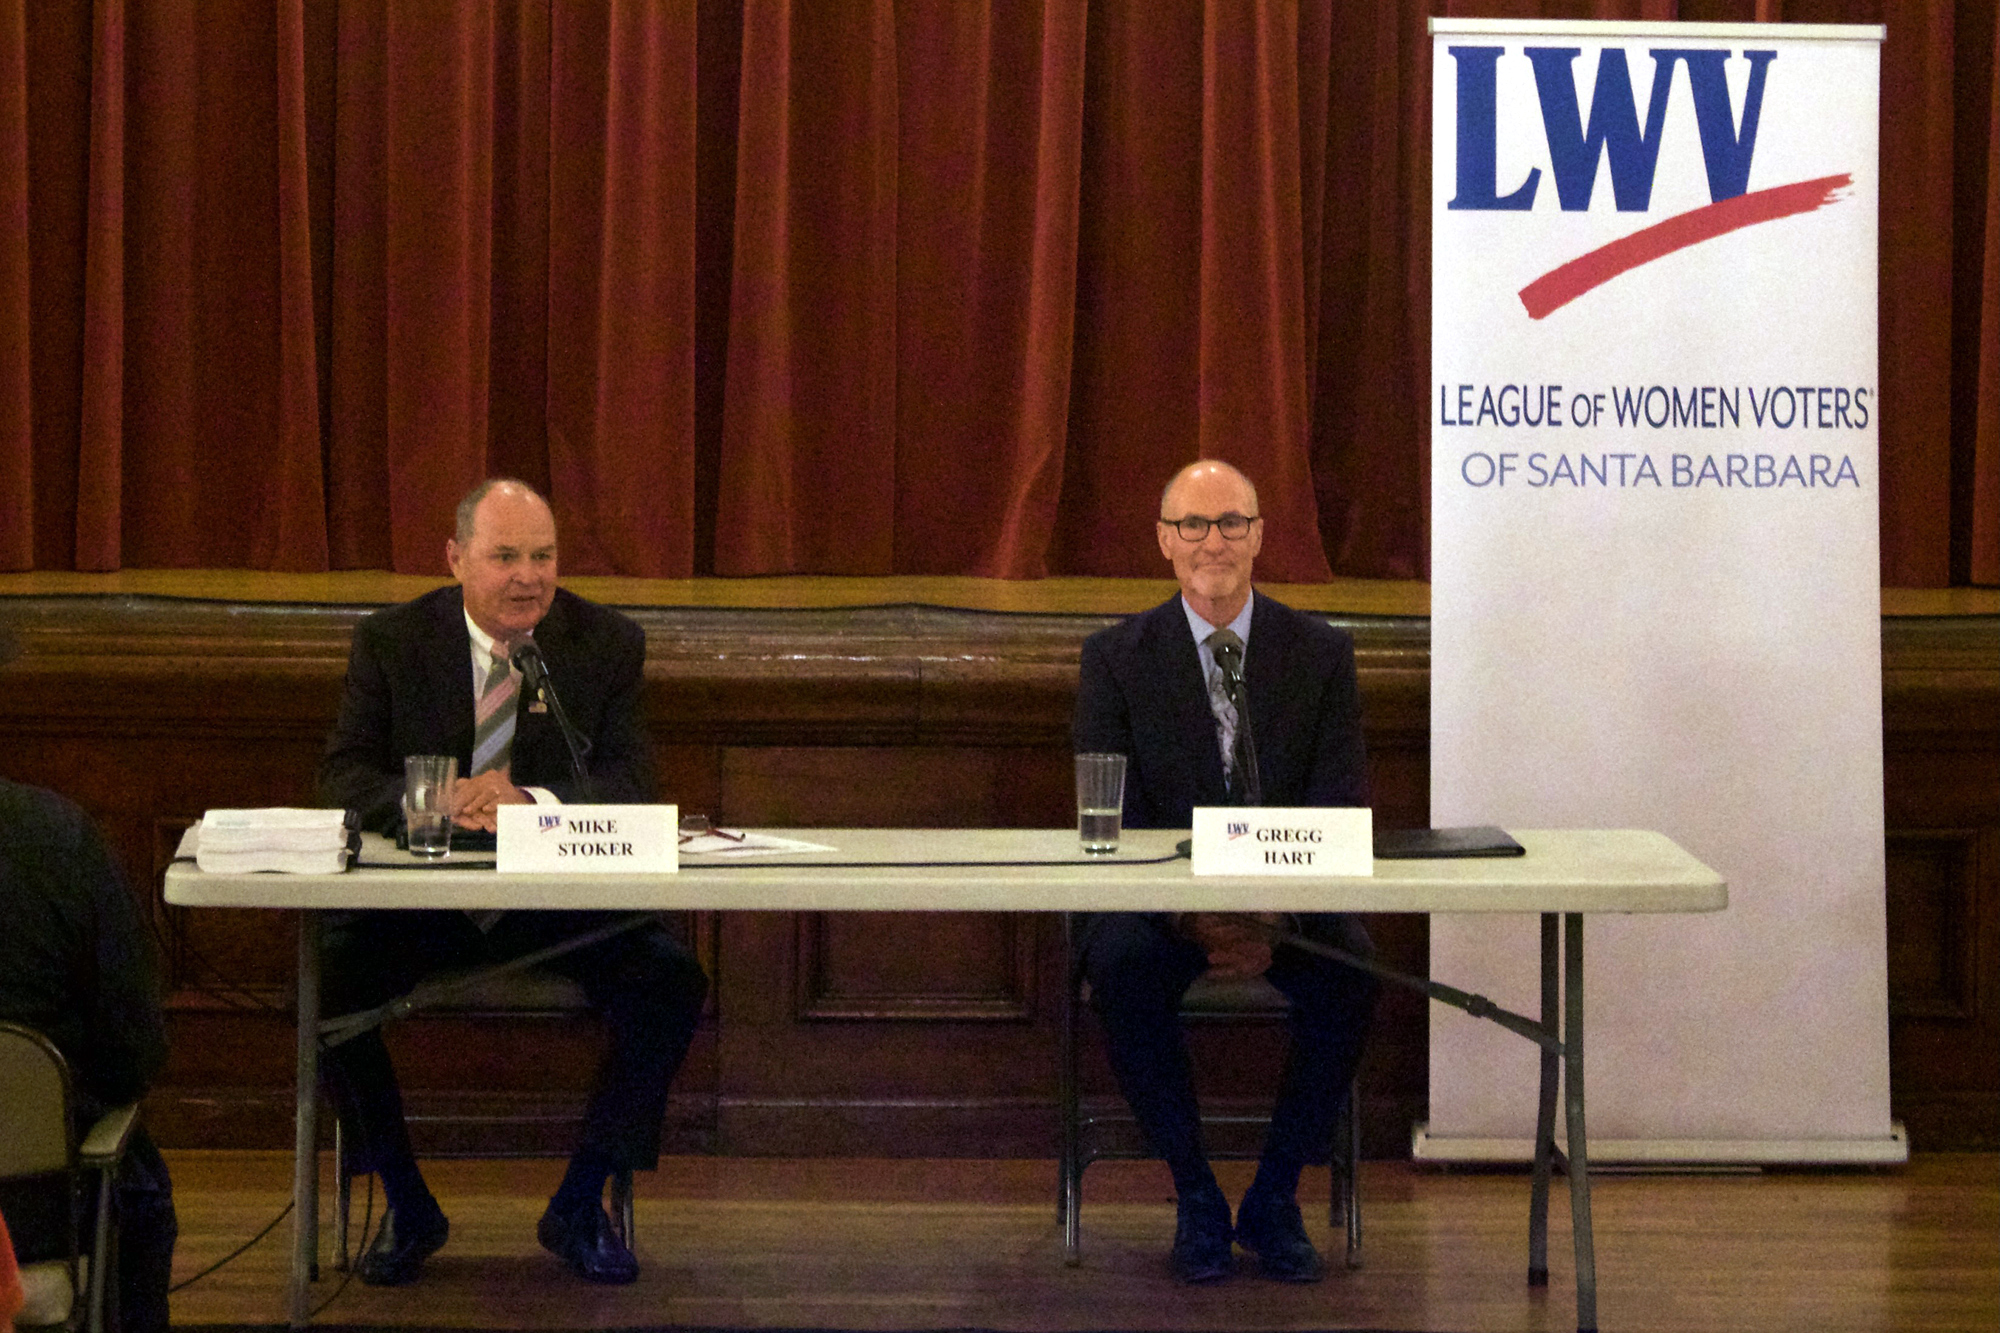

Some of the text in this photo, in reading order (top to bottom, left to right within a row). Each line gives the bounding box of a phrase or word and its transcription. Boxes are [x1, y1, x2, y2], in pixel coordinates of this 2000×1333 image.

[1447, 45, 1777, 212] LWV
[1441, 384, 1562, 428] LEAGUE
[1571, 394, 1606, 427] OF
[1612, 386, 1740, 428] WOMEN
[1461, 452, 1860, 488] OF SANTA BARBARA
[538, 815, 562, 828] LWV
[568, 820, 618, 834] MIKE
[1227, 823, 1249, 835] LWV
[1256, 829, 1323, 843] GREGG
[558, 843, 634, 857] STOKER
[1265, 851, 1316, 865] HART
